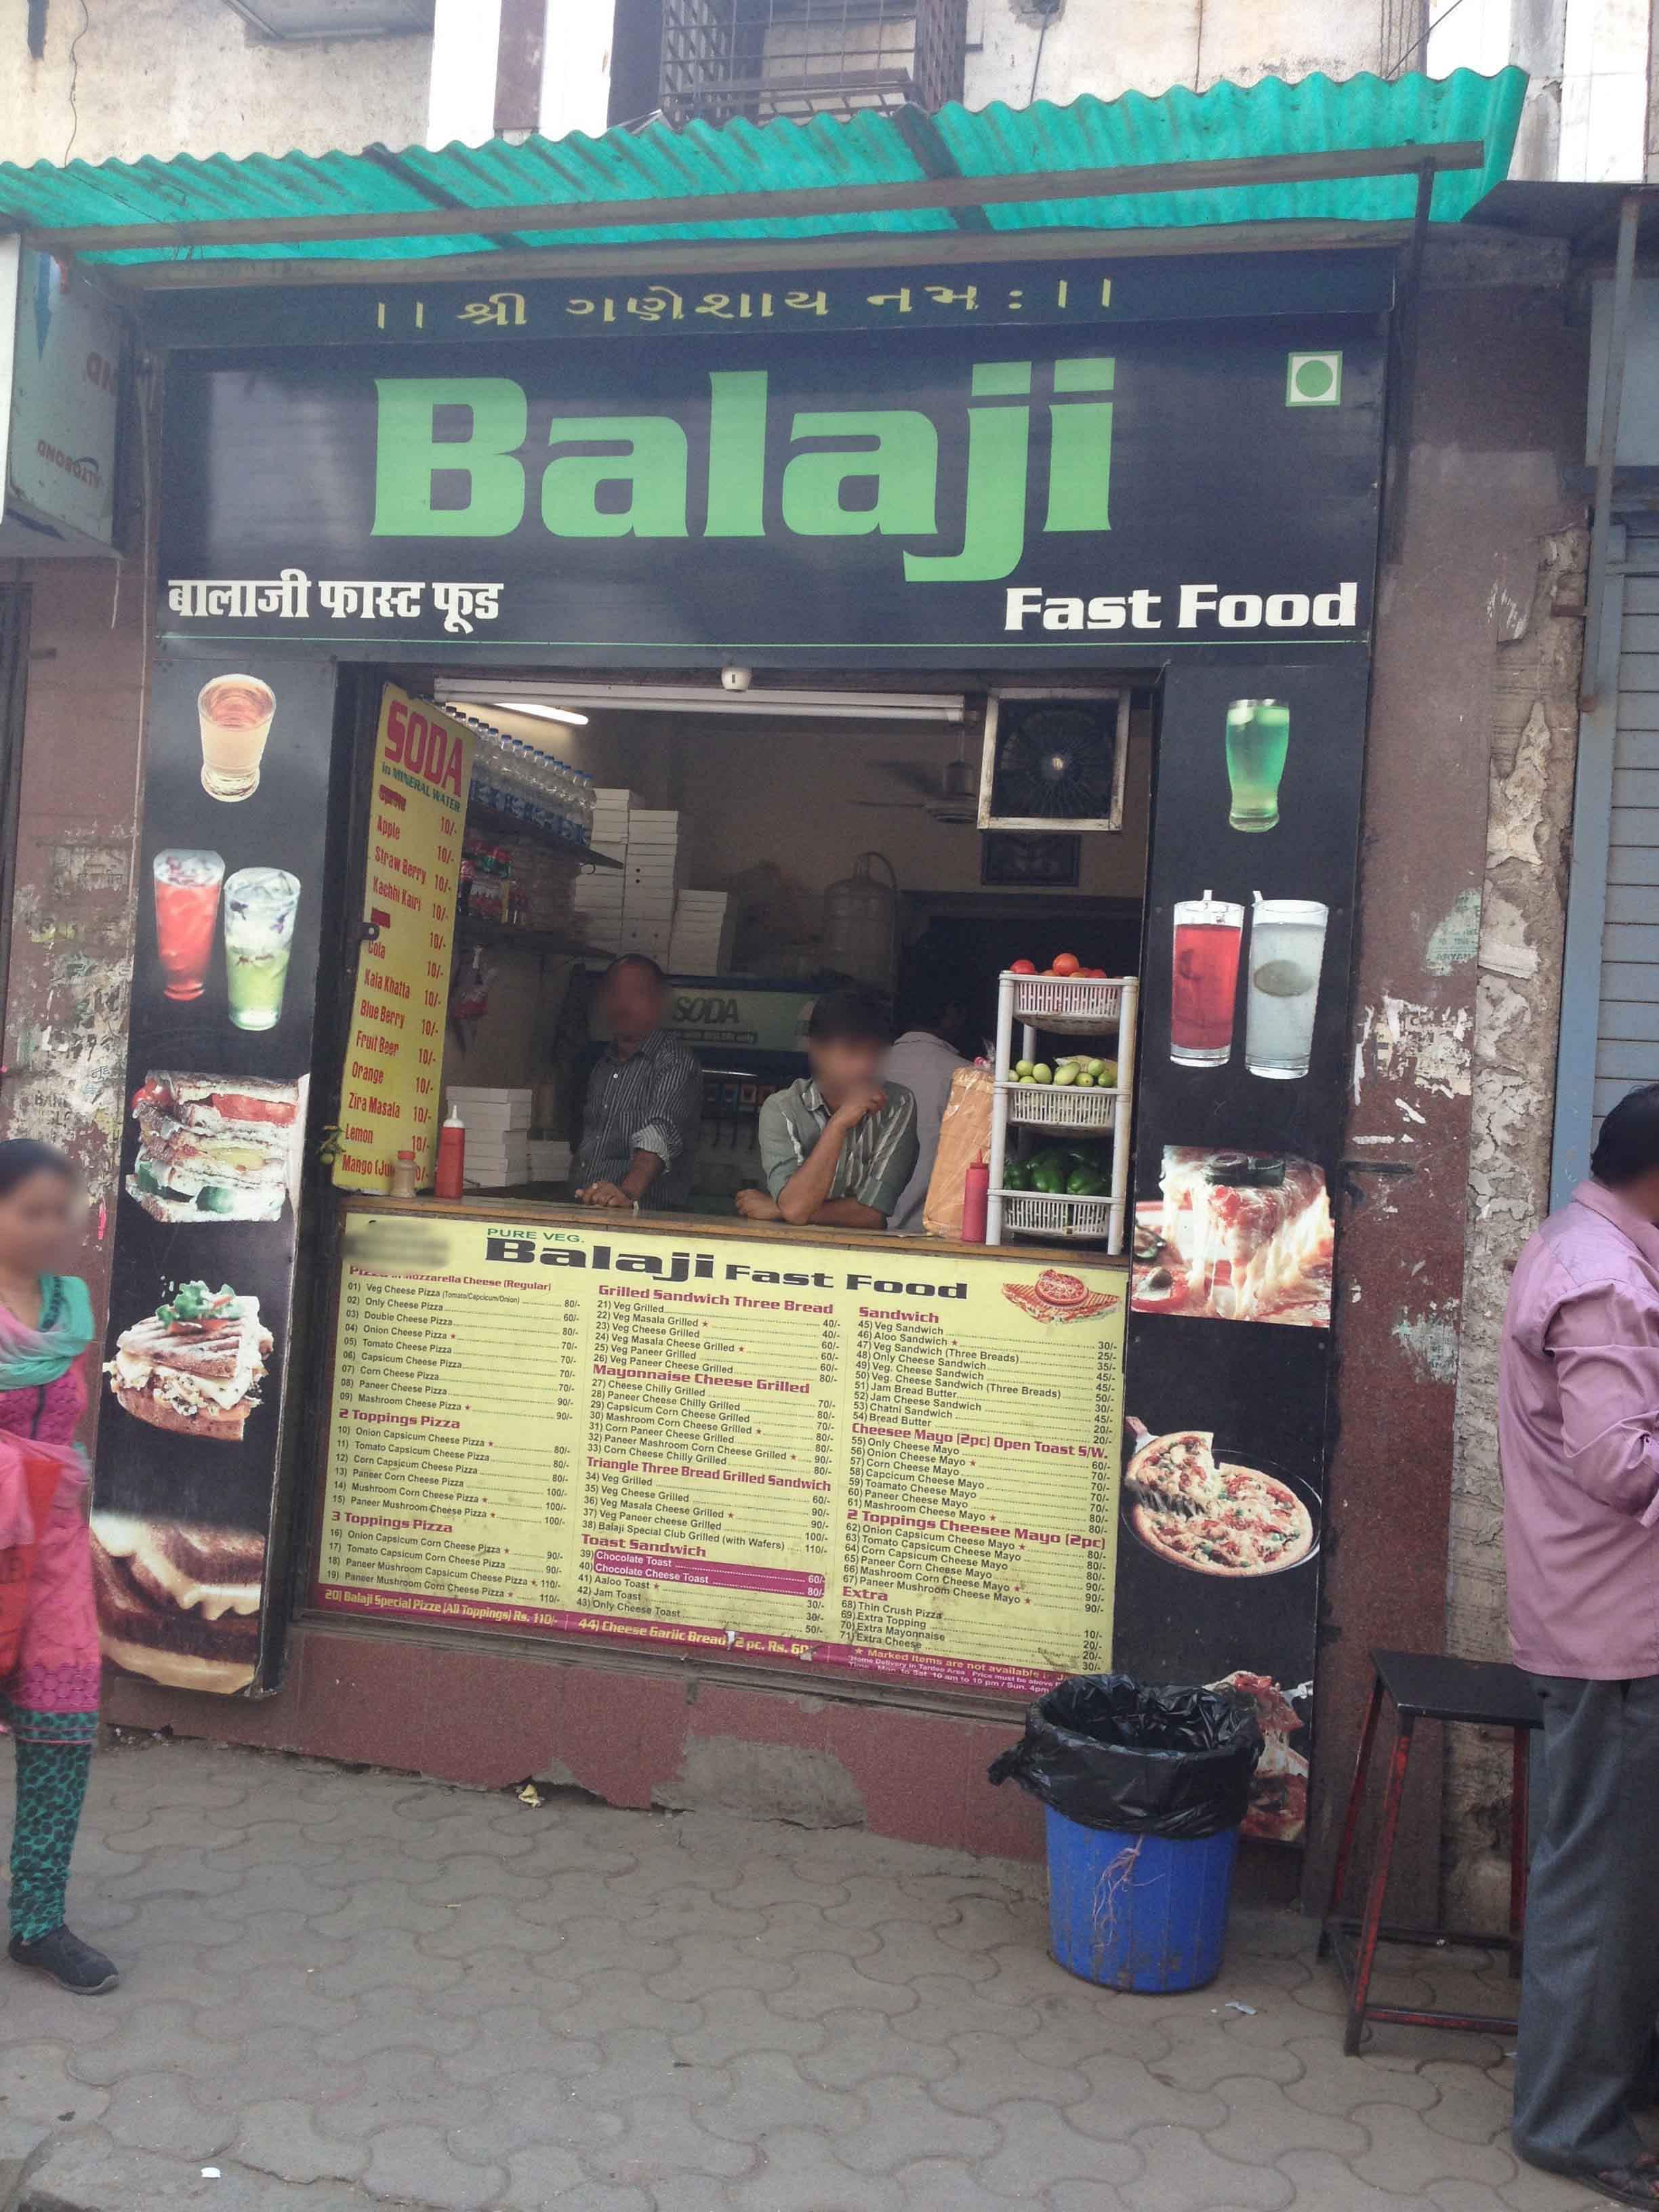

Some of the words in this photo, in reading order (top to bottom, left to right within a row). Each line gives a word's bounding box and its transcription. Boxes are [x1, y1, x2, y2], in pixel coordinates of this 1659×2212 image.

[370, 357, 1116, 583] Balaji
[168, 568, 311, 619] बालाजी
[318, 580, 425, 619] फास्ट
[432, 580, 505, 634] फूड
[1004, 587, 1162, 631] Fast
[1178, 582, 1358, 629] Food
[384, 701, 463, 794] SODA
[382, 761, 390, 775] in
[392, 767, 430, 797] MINERAL
[432, 787, 461, 813] WATER
[377, 815, 400, 840] Apple
[437, 845, 454, 864] 10/-
[441, 816, 457, 836] 10/-
[375, 845, 401, 872] Straw
[402, 858, 426, 884] Berry
[434, 874, 451, 893] 10/-
[373, 876, 400, 903] Kachhi
[432, 903, 448, 922] 10/-
[430, 932, 446, 950] 10/-
[367, 938, 385, 959] Cola
[427, 960, 443, 979] 10/-
[384, 975, 410, 999] Khatta
[424, 989, 441, 1007] 10/-
[360, 999, 379, 1019] Blue
[380, 1005, 405, 1029] Berry
[422, 1019, 438, 1036] 10/-
[674, 996, 739, 1024] SODA
[356, 1029, 377, 1052] Fruit
[378, 1036, 398, 1056] Beer
[418, 1048, 436, 1065] 10/-
[352, 1061, 384, 1084] Orange
[416, 1077, 433, 1094] 10/-
[348, 1092, 367, 1111] Zira
[368, 1096, 400, 1118] Masala
[413, 1105, 431, 1123] 10/-
[344, 1123, 373, 1144] Lemon
[409, 1135, 431, 1154] 10/-
[342, 1153, 372, 1175] Mango
[415, 1164, 430, 1183] 0/-
[487, 1227, 537, 1239] PURE
[542, 1232, 584, 1243] VEG.
[463, 1275, 501, 1286] Cheese
[504, 1279, 551, 1291] (Regular)
[485, 1236, 714, 1282] Balaji
[725, 1264, 834, 1288] Fast
[846, 1273, 967, 1299] Food
[346, 1295, 360, 1305] 02)
[365, 1296, 385, 1308] Only
[386, 1298, 419, 1309] Cheese
[420, 1300, 443, 1311] Pizza
[563, 1313, 579, 1322] 60/-
[598, 1284, 649, 1298] Grilled
[653, 1289, 729, 1305] Sandwich
[733, 1295, 780, 1309] Three
[783, 1300, 833, 1313] Bread
[859, 1306, 939, 1323] Sandwich
[596, 1310, 611, 1321] 22)
[613, 1311, 630, 1323] Veg
[632, 1313, 665, 1324] Masala
[667, 1316, 698, 1327] Grilled
[821, 1330, 840, 1338] 40/-
[857, 1330, 872, 1340] 46)
[873, 1331, 897, 1341] Aloo
[899, 1333, 947, 1345] Sandwich
[1097, 1351, 1116, 1361] 25/-
[592, 1364, 691, 1382] Mayonnaise
[694, 1373, 753, 1388] Cheese
[756, 1378, 809, 1393] Grilled
[590, 1389, 605, 1400] 28)
[607, 1390, 640, 1401] Paneer
[642, 1393, 677, 1404] Cheese
[679, 1397, 706, 1409] Chilly
[708, 1399, 740, 1411] Grilled
[817, 1410, 835, 1420] 80/-
[854, 1380, 869, 1391] 51)
[870, 1382, 891, 1392] Jam
[894, 1384, 923, 1395] Bread
[926, 1387, 957, 1398] Butter
[1094, 1403, 1113, 1413] 30/-
[338, 1408, 348, 1418] 2
[352, 1409, 417, 1427] Toppings
[420, 1415, 459, 1429] Pizza
[851, 1422, 911, 1438] Cheesee
[914, 1429, 953, 1444] Mayo
[956, 1433, 989, 1448] (2pc)
[994, 1436, 1030, 1451] Open
[1033, 1440, 1075, 1455] Toast
[1078, 1445, 1107, 1458] S/W.
[335, 1467, 347, 1477] 13)
[352, 1468, 382, 1479] Paneer
[384, 1471, 405, 1481] Corn
[407, 1473, 439, 1485] Cheese
[441, 1477, 464, 1487] Pizza
[546, 1487, 567, 1496] 100/-
[586, 1456, 638, 1472] Triangle
[641, 1461, 678, 1475] Three
[681, 1465, 720, 1479] Bread
[722, 1469, 765, 1484] Grilled
[767, 1474, 831, 1491] Sandwich
[848, 1467, 864, 1479] 58)
[865, 1468, 914, 1481] Capcicum
[917, 1473, 954, 1486] Cheese
[958, 1477, 984, 1490] Mayo
[1090, 1492, 1109, 1502] 70/-
[581, 1519, 596, 1531] 38)
[598, 1521, 624, 1534] Balaji
[626, 1524, 661, 1536] Special
[663, 1528, 686, 1539] Club
[688, 1530, 720, 1542] Grilled
[722, 1534, 745, 1545] (with
[747, 1537, 784, 1551] Wafers)
[804, 1544, 827, 1554] 110/-
[581, 1534, 626, 1549] Toast
[629, 1538, 705, 1557] Sandwich
[846, 1509, 857, 1520] 2
[861, 1510, 936, 1530] Toppings
[939, 1519, 1010, 1538] Cheesee
[1014, 1528, 1061, 1544] Mayo
[1065, 1533, 1105, 1550] (2pc)
[579, 1549, 594, 1561] 39)
[595, 1549, 643, 1563] Chocolate
[645, 1555, 672, 1567] Toast
[808, 1574, 825, 1584] 60/-
[325, 1589, 342, 1601] 20)
[842, 1585, 888, 1601] Extra
[840, 1620, 856, 1633] 70)
[855, 1622, 882, 1634] Extra
[885, 1625, 945, 1641] Mayonnaise
[1082, 1650, 1102, 1661] 20/-
